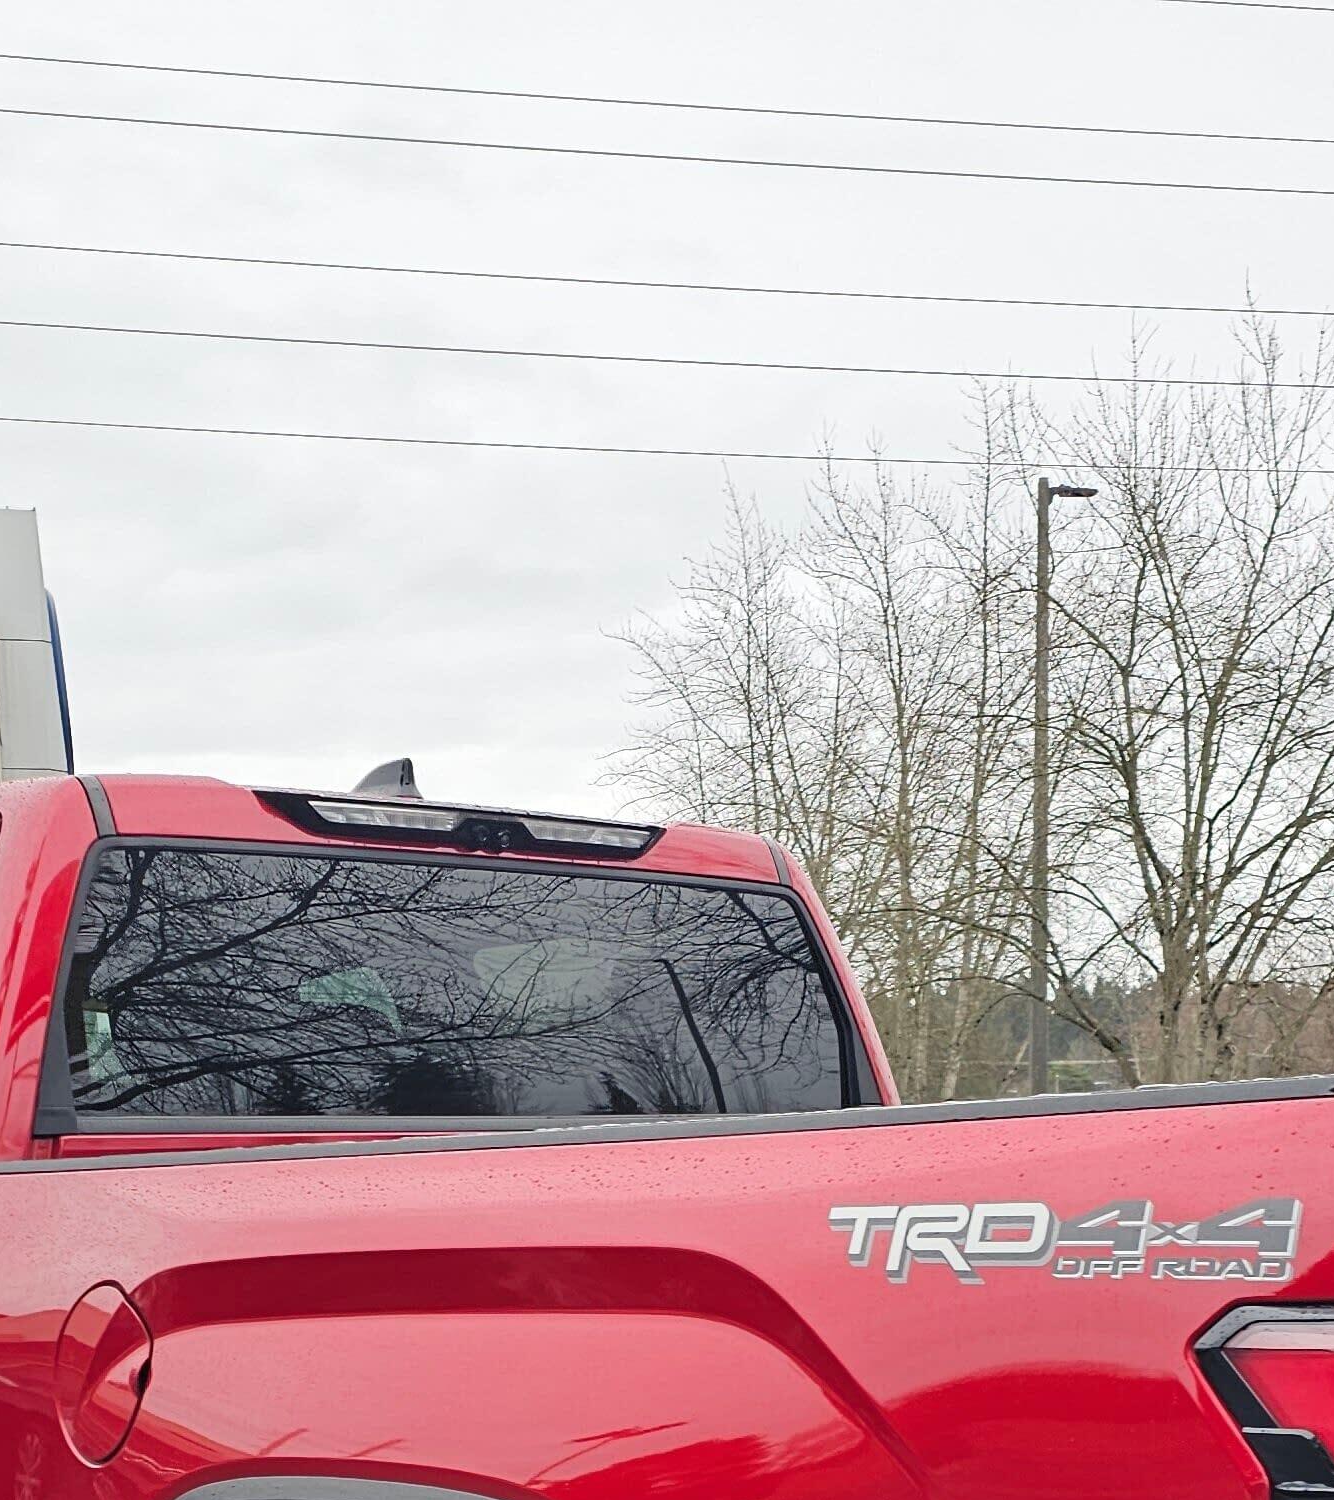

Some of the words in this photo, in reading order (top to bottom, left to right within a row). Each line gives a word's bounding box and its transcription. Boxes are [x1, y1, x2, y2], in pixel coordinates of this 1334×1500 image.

[828, 1201, 1058, 1285] TRD
[1052, 1256, 1145, 1279] OFF
[1150, 1257, 1293, 1282] ROAD
